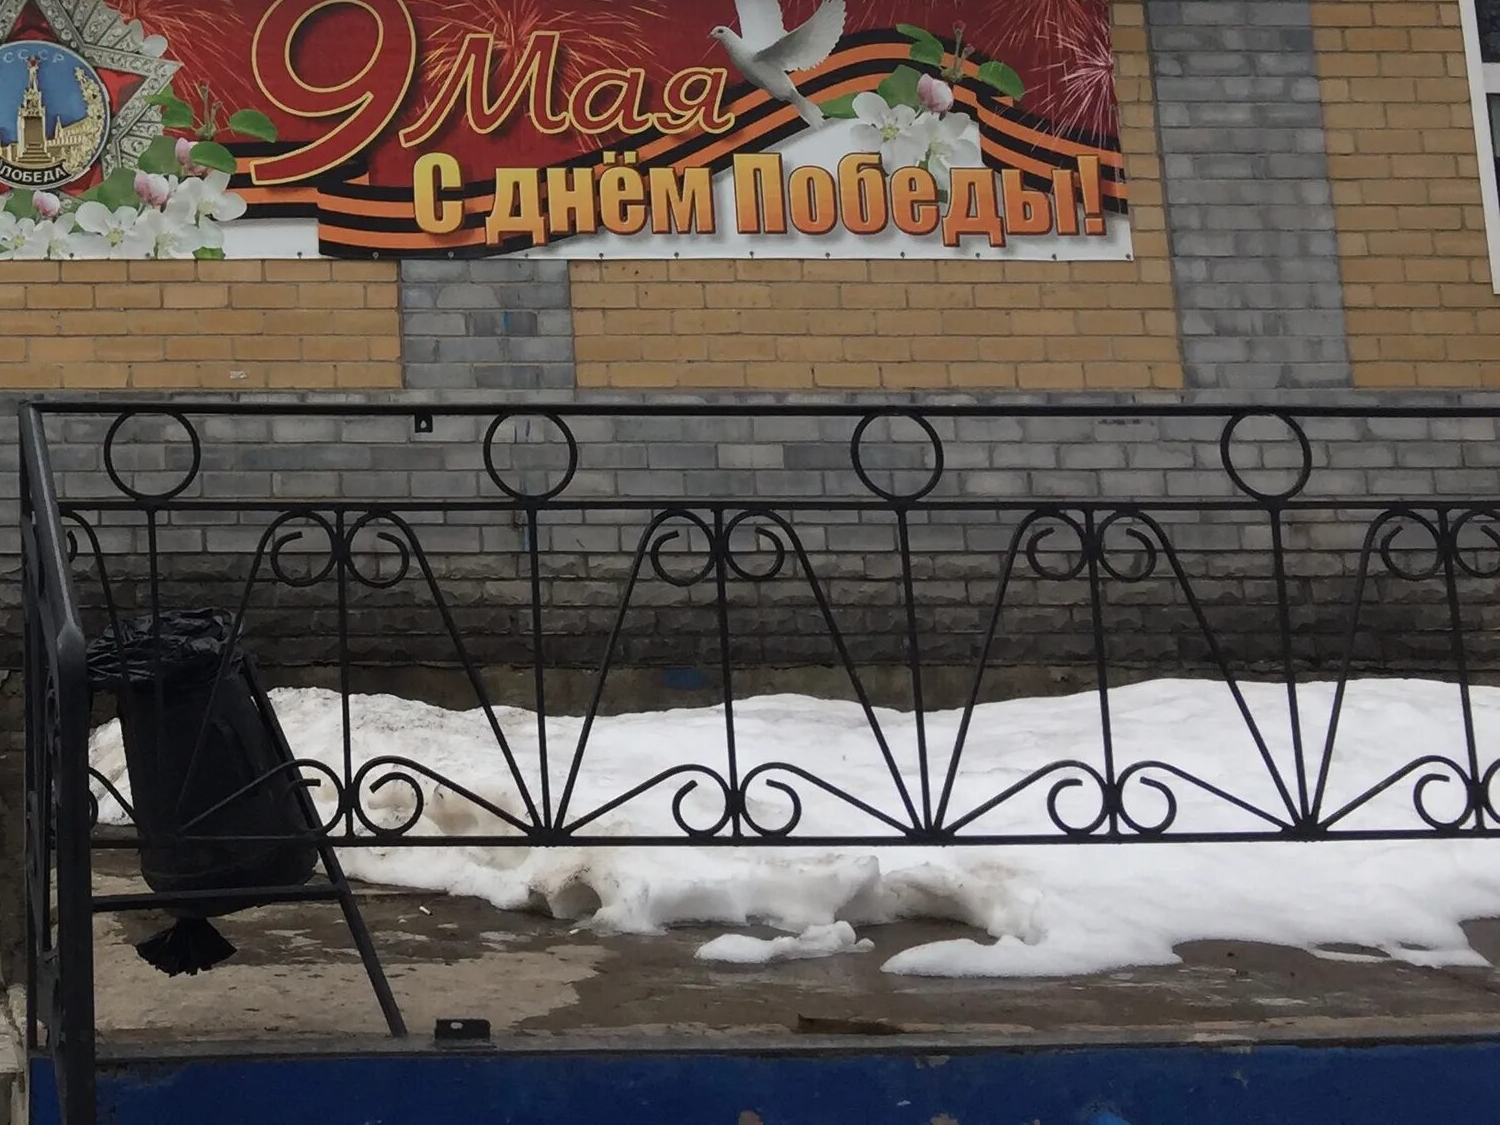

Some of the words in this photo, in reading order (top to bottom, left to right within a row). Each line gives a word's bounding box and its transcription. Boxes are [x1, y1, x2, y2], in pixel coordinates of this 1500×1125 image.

[2, 48, 65, 65] СССР
[399, 31, 738, 150] Мая
[0, 165, 68, 183] ПОБЕДА
[411, 151, 468, 236] С
[730, 151, 1110, 250] Победы!
